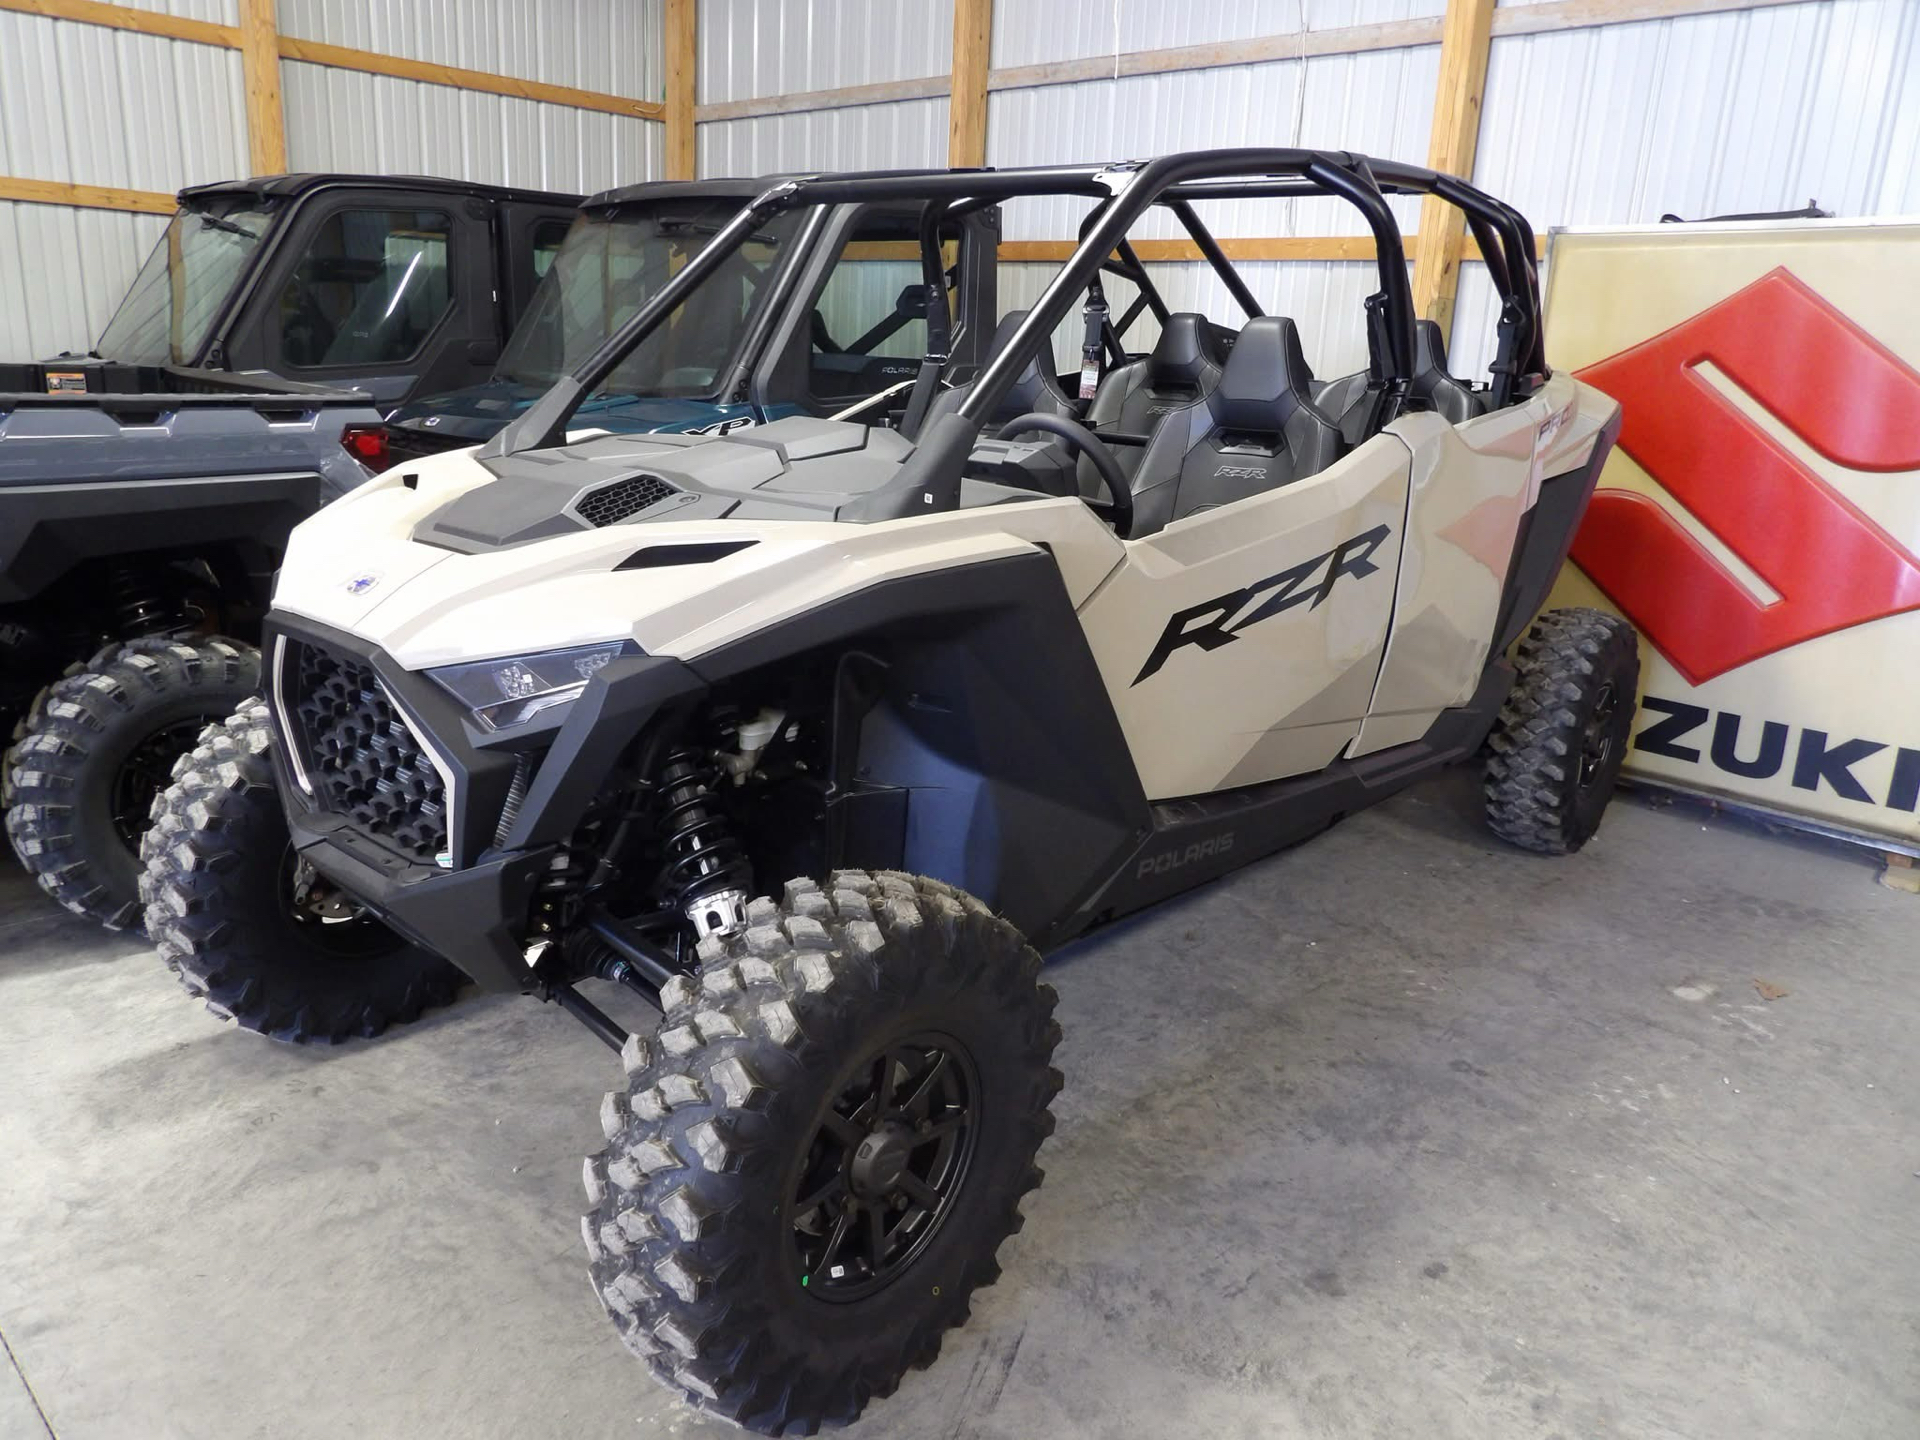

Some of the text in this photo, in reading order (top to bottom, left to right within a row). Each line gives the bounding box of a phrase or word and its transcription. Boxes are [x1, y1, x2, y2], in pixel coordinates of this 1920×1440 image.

[881, 366, 919, 375] POLARIS
[1214, 465, 1267, 479] RZR
[1129, 523, 1392, 689] RZR
[1633, 695, 1920, 813] ZUKI
[1137, 832, 1235, 879] POLARIS
